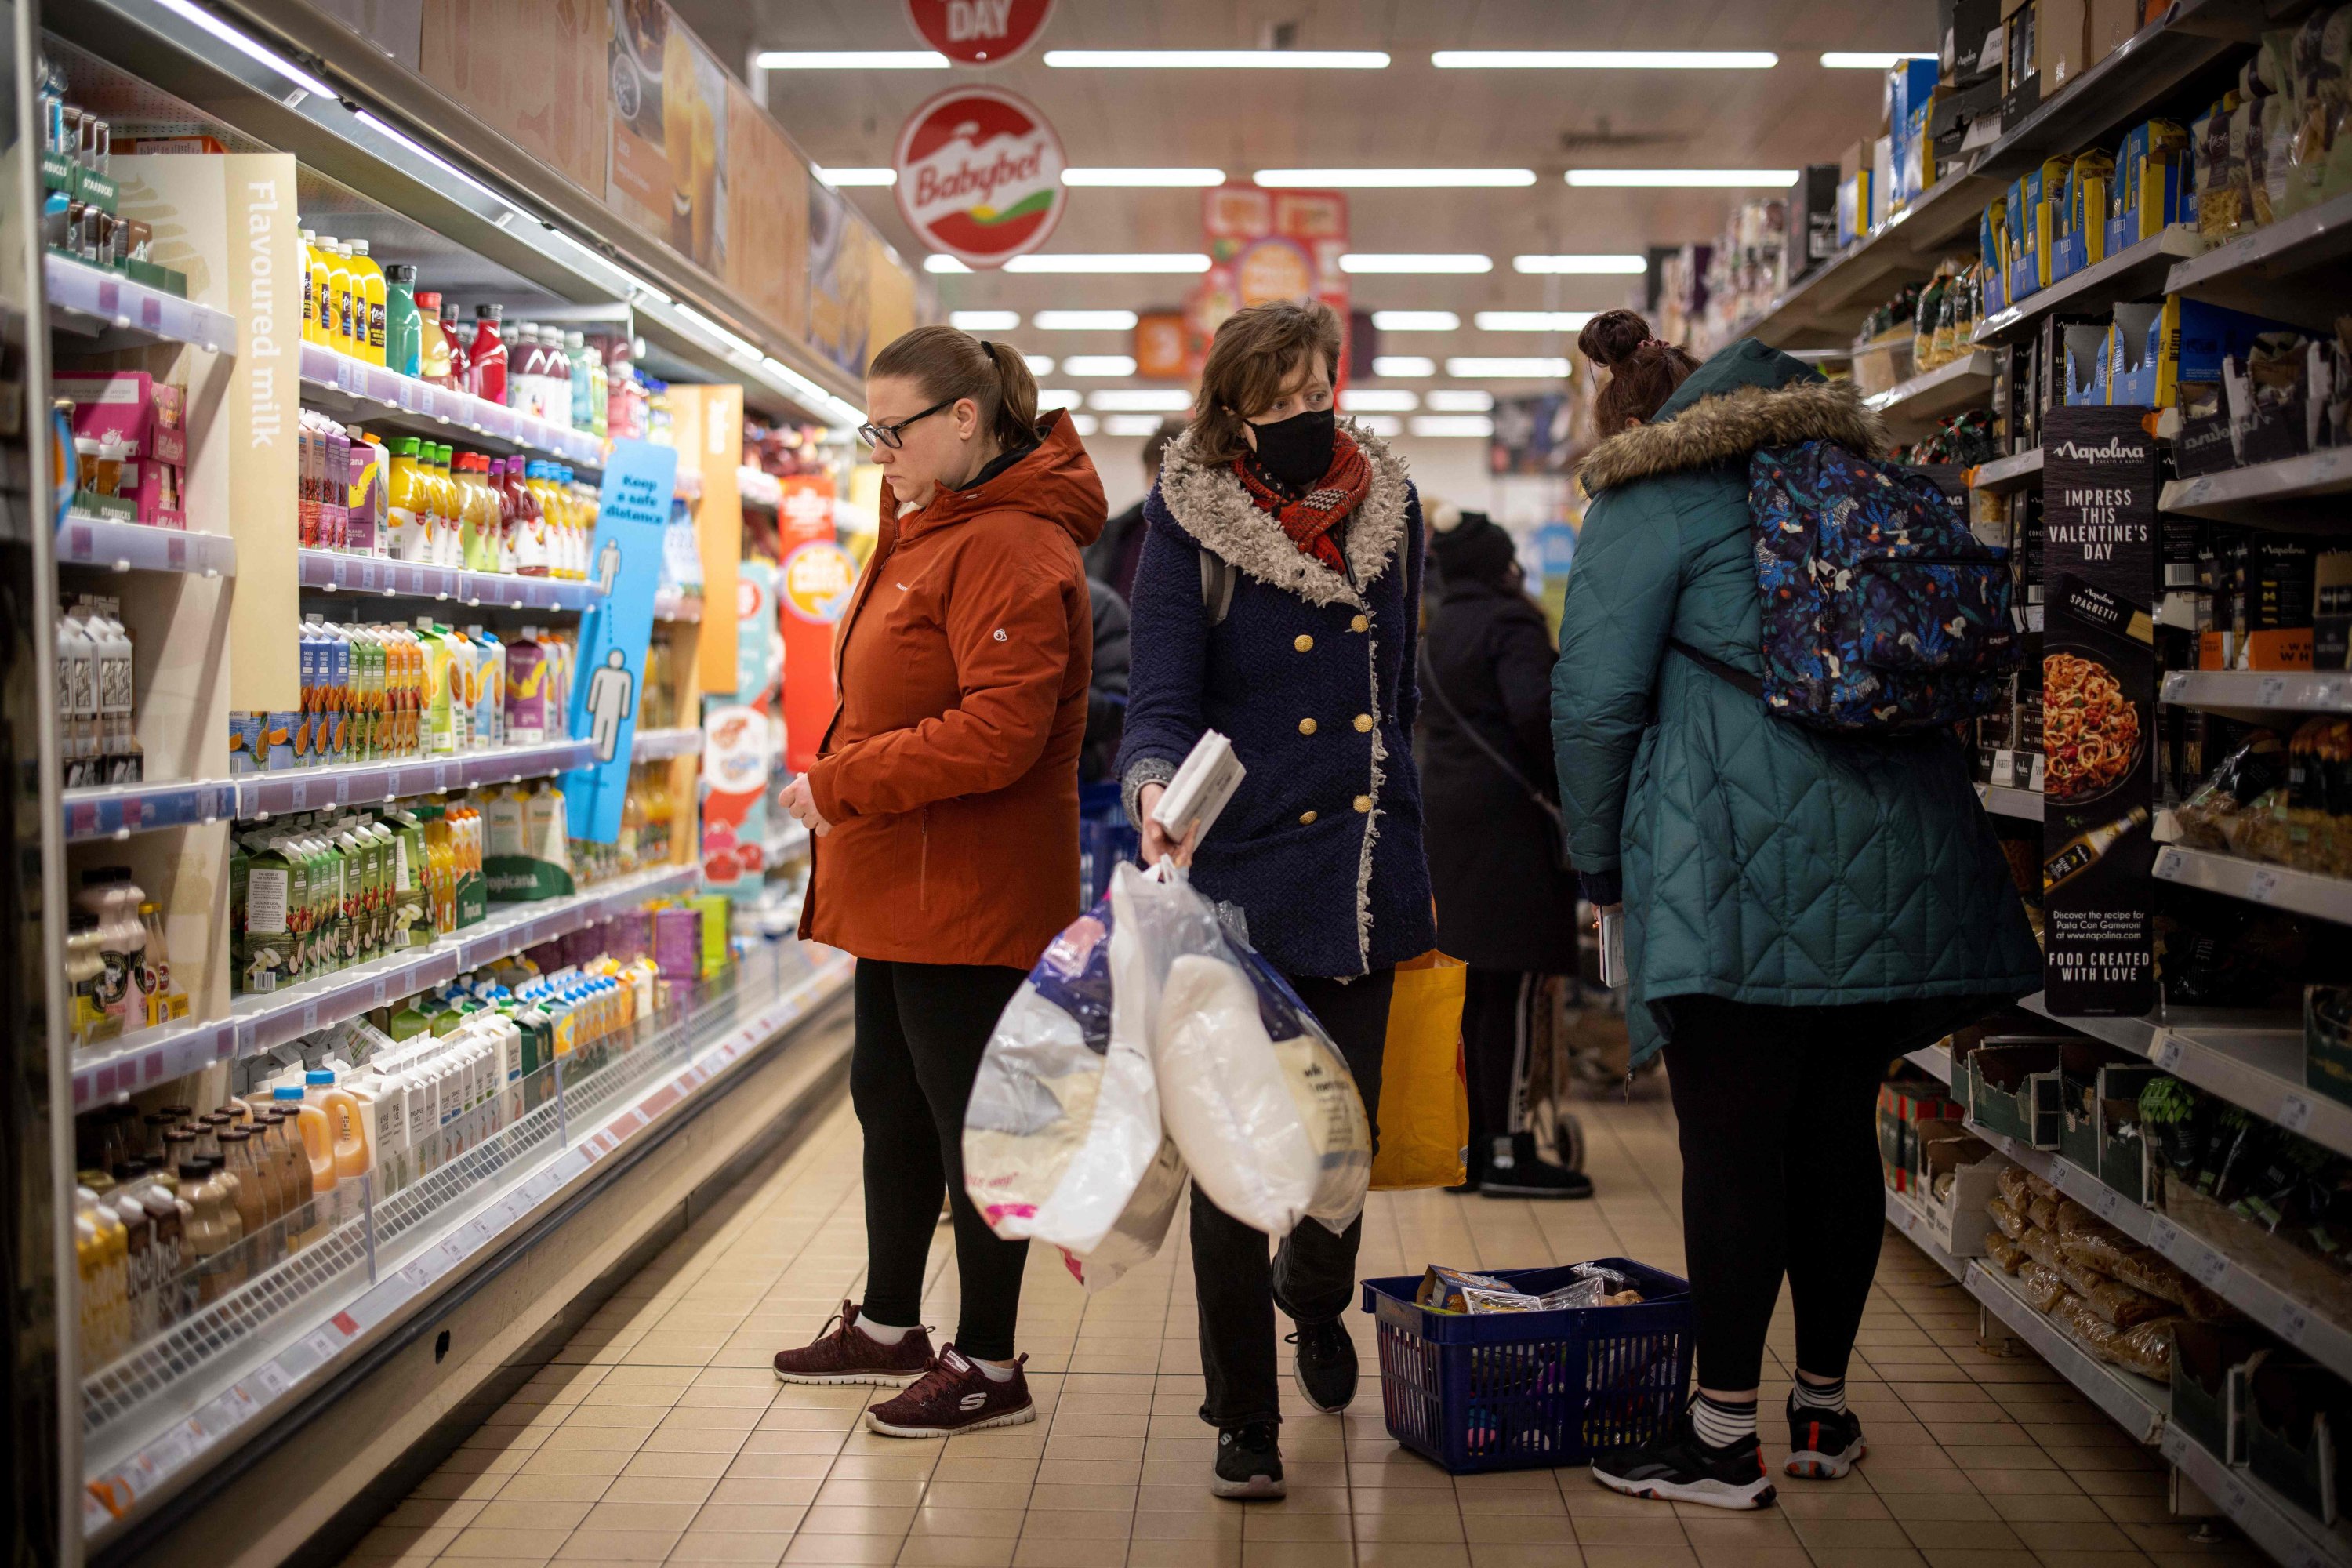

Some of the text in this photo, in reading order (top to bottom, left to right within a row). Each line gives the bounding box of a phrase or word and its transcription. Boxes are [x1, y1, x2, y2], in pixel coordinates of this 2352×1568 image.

[946, 0, 1013, 42] DAY
[916, 141, 1044, 209] Babybel
[83, 177, 113, 198] STARBUCKS
[248, 180, 281, 448] Flavoured milk
[2053, 437, 2144, 464] Napolina
[623, 476, 657, 492] Keep
[629, 493, 657, 507] safe
[2065, 489, 2132, 506] IMPRESS
[101, 506, 131, 521] STARBUCKS
[606, 505, 663, 524] distance
[2081, 507, 2115, 524] THIS
[2049, 525, 2147, 542] VALENTINE'S
[2084, 543, 2113, 560] DAY
[2084, 588, 2114, 605] Napolina
[2070, 593, 2118, 622] SPAGHETTI
[2053, 910, 2145, 920] Discover the recipe for
[2067, 931, 2142, 941] www.napolina.com
[2049, 953, 2149, 966] FOOD CREATED
[2061, 967, 2136, 981] WITH LOVE
